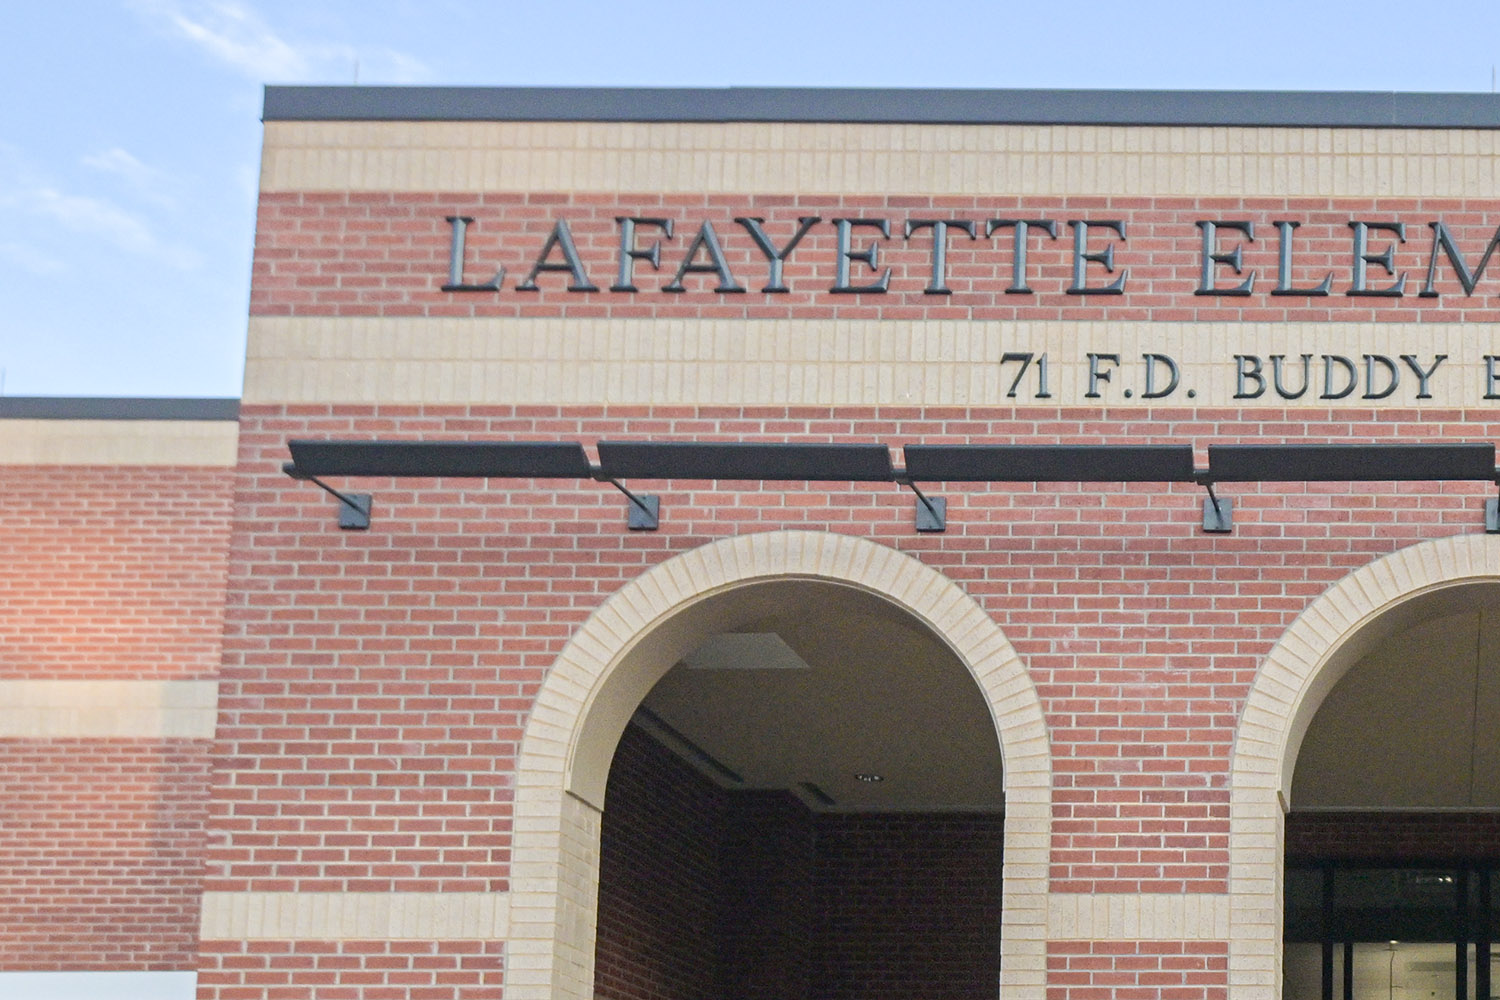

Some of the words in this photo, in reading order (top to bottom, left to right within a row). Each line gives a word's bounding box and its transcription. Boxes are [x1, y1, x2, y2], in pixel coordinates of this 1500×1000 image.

[440, 215, 1128, 296] LAFAYETTE
[999, 351, 1052, 399] 71
[1084, 352, 1197, 399] F.D.
[1233, 353, 1449, 400] BUDDY
